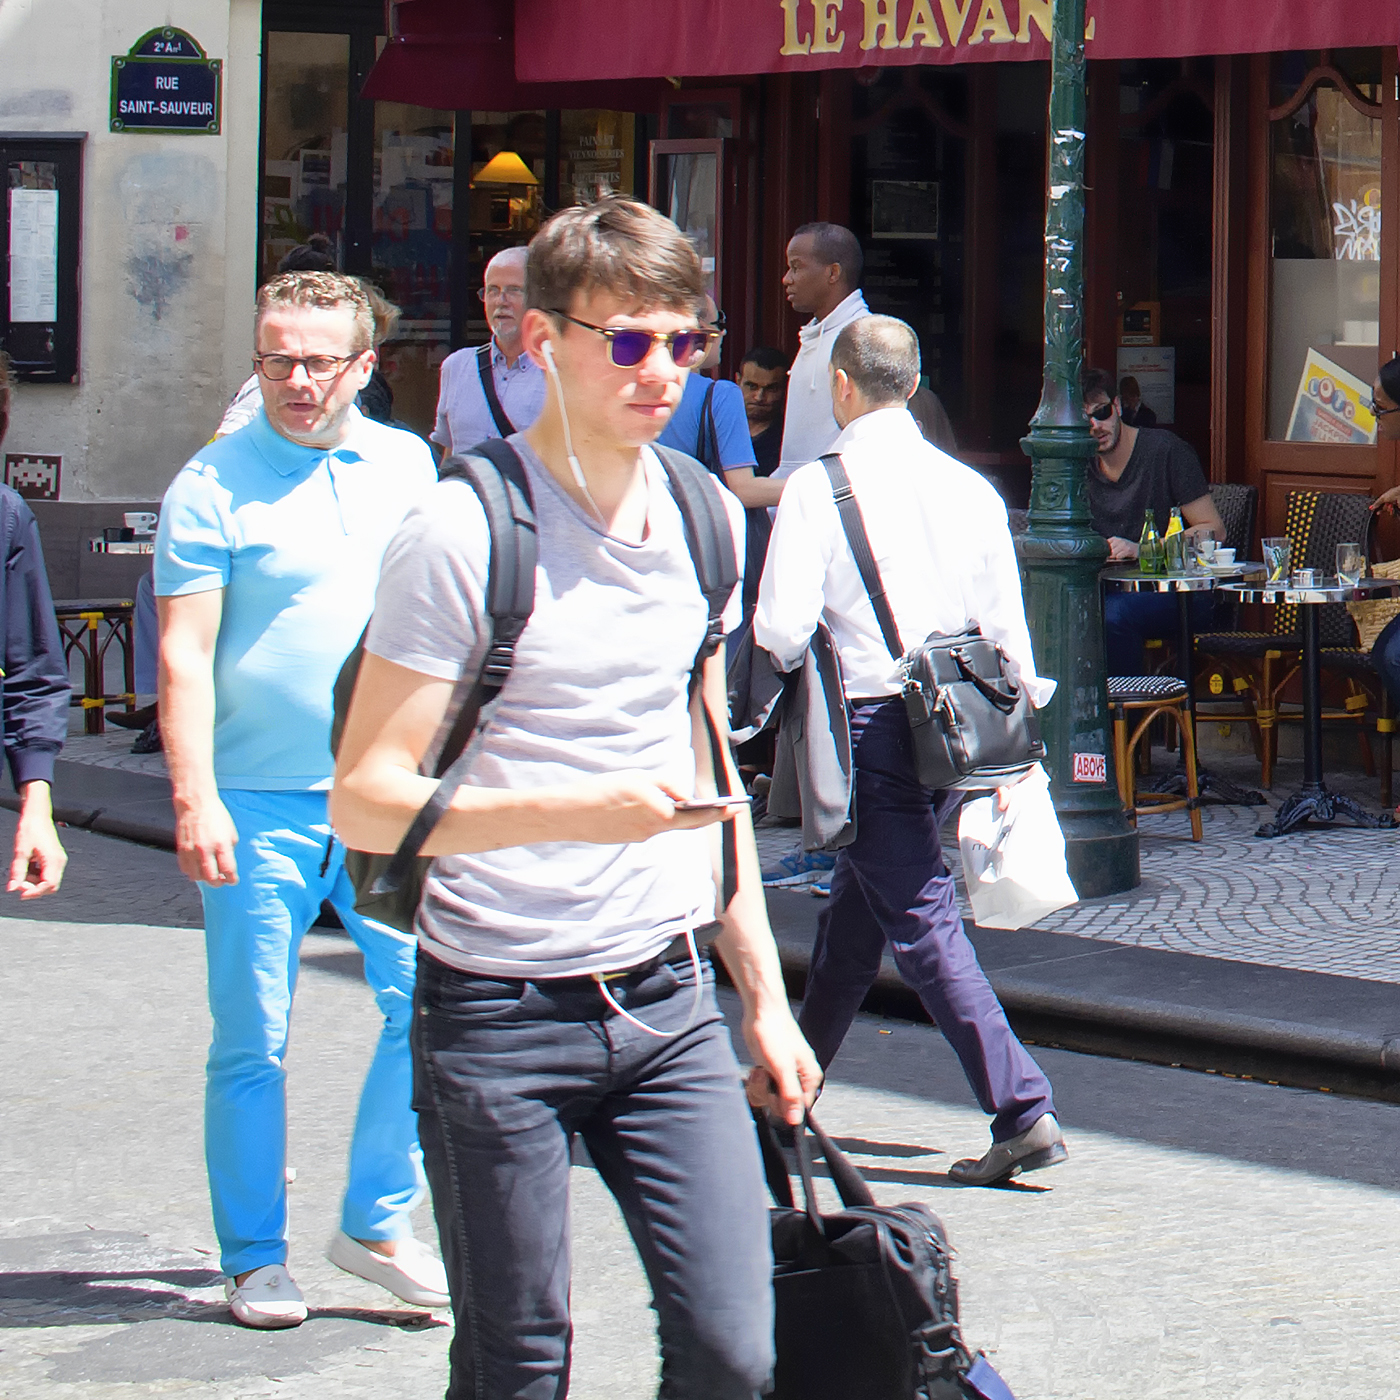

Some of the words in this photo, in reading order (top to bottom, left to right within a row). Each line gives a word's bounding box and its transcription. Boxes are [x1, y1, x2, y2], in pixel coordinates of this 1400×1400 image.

[155, 76, 179, 90] RUE
[119, 100, 213, 115] SAINT-SAUVEUR
[1309, 376, 1355, 420] LOTO
[1077, 757, 1105, 776] ABOVE
